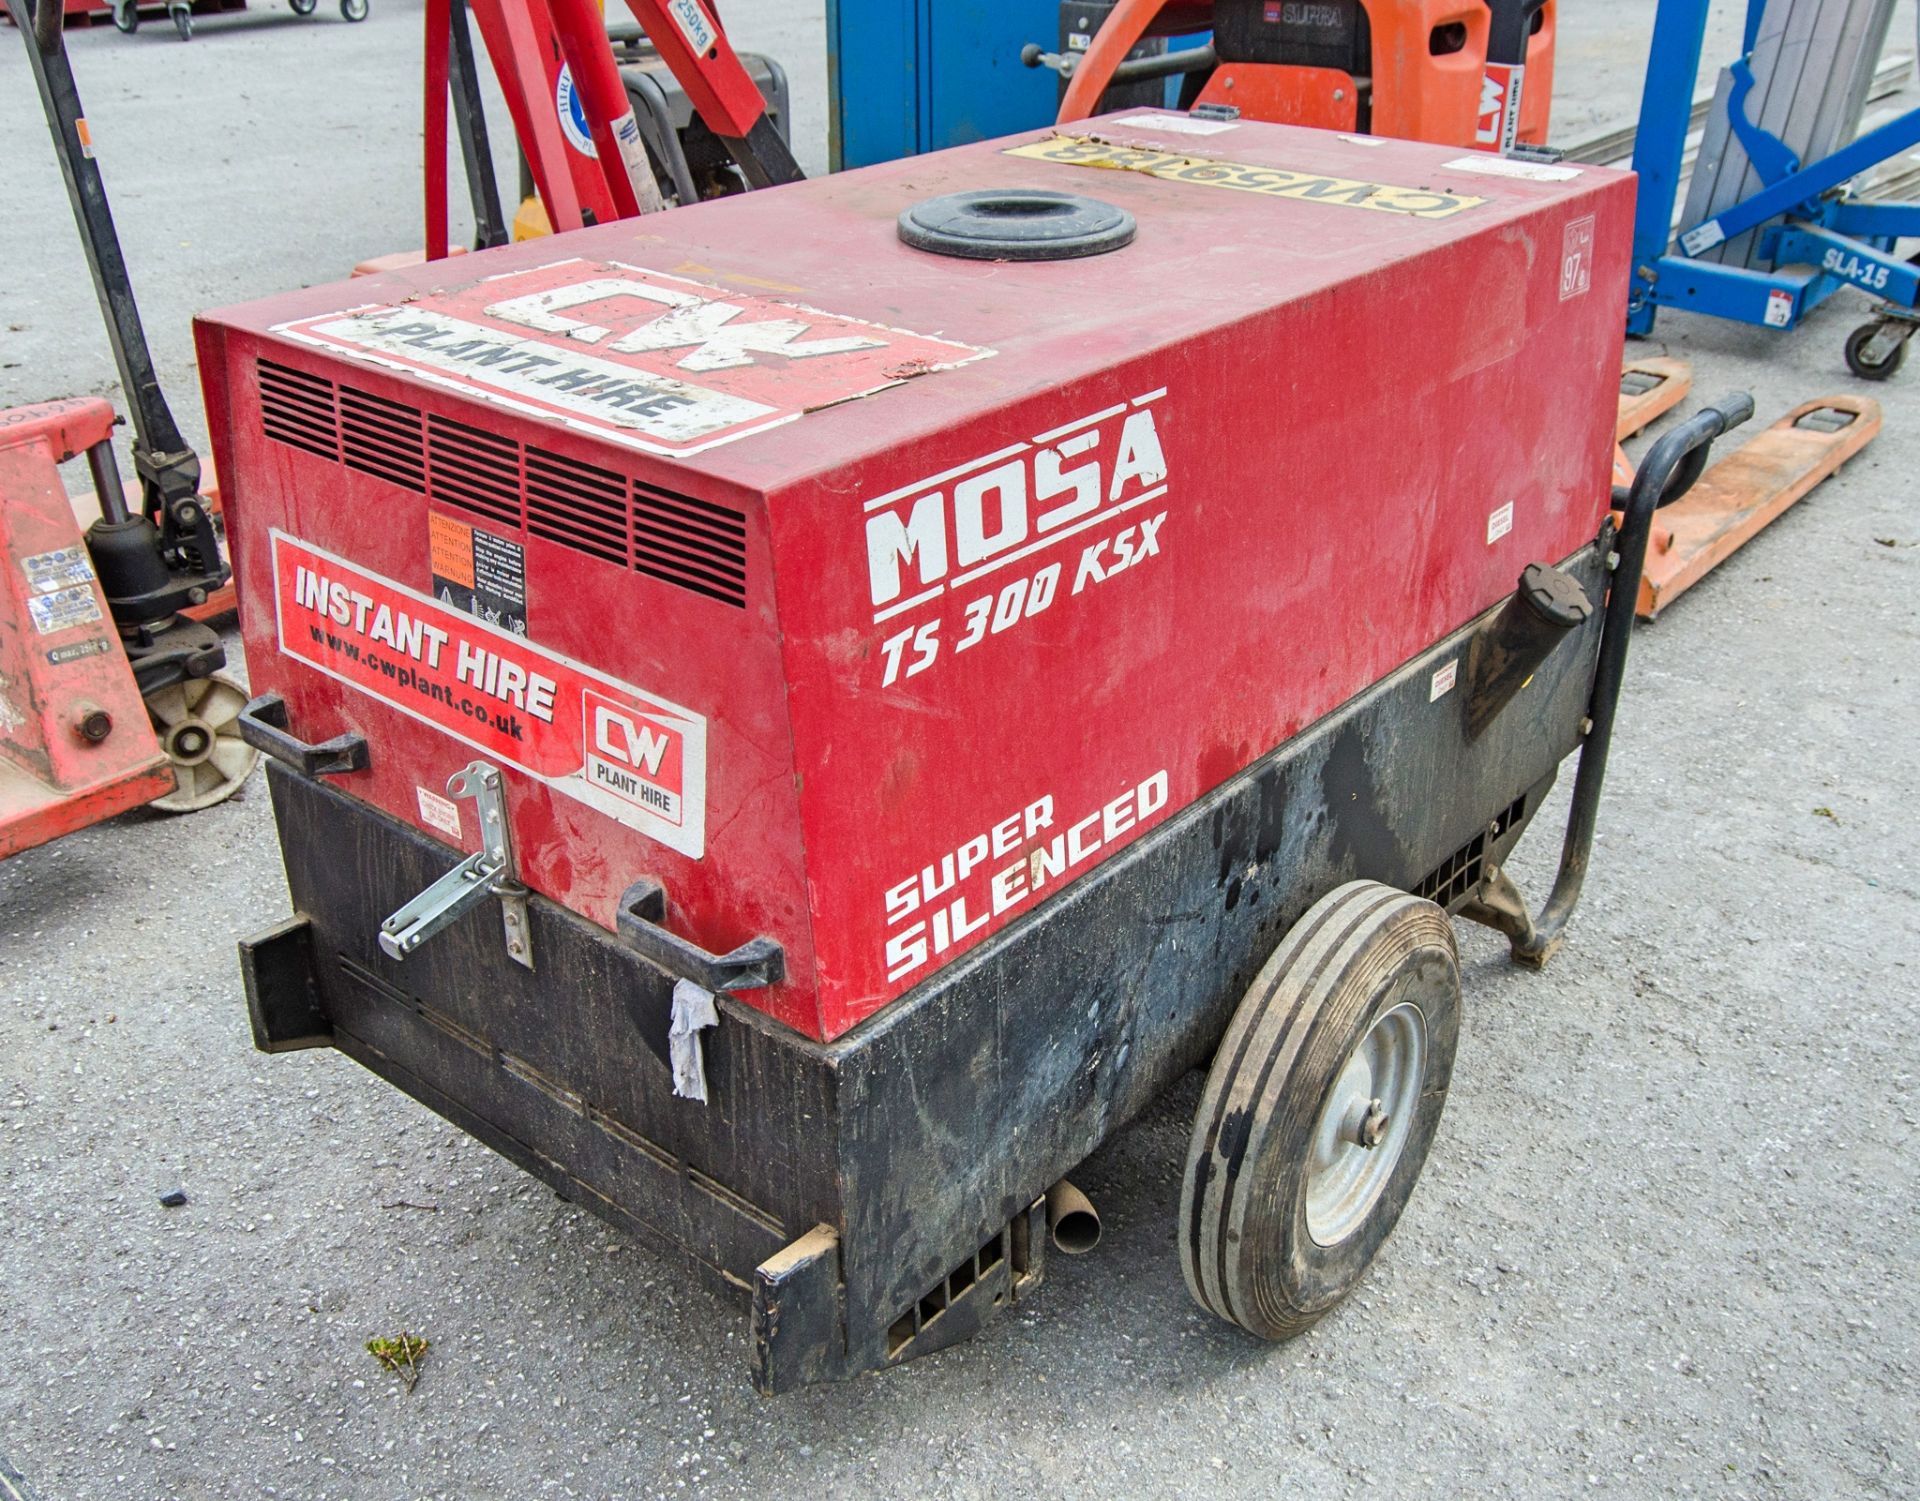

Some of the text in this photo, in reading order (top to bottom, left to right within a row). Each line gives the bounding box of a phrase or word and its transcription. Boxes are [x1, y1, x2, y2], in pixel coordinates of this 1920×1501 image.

[1505, 110, 1516, 148] PLANT
[1822, 247, 1890, 290] SLA-15
[379, 322, 696, 419] PLANT HIRE
[430, 515, 471, 538] ATTENZIONE
[431, 530, 472, 553] ATTENTION
[865, 409, 1167, 606] MOSA
[432, 545, 473, 568] ATTENTION
[433, 561, 474, 584] WARNUNG
[881, 511, 1167, 689] TS 300 KSX
[295, 565, 558, 724] INSTANT HIRE
[309, 624, 524, 742] www.cwplant.co.uk
[595, 705, 670, 778] CW
[597, 763, 670, 813] PLANT HIRE
[885, 794, 1054, 926] SUPER
[885, 769, 1168, 984] SILENCED
